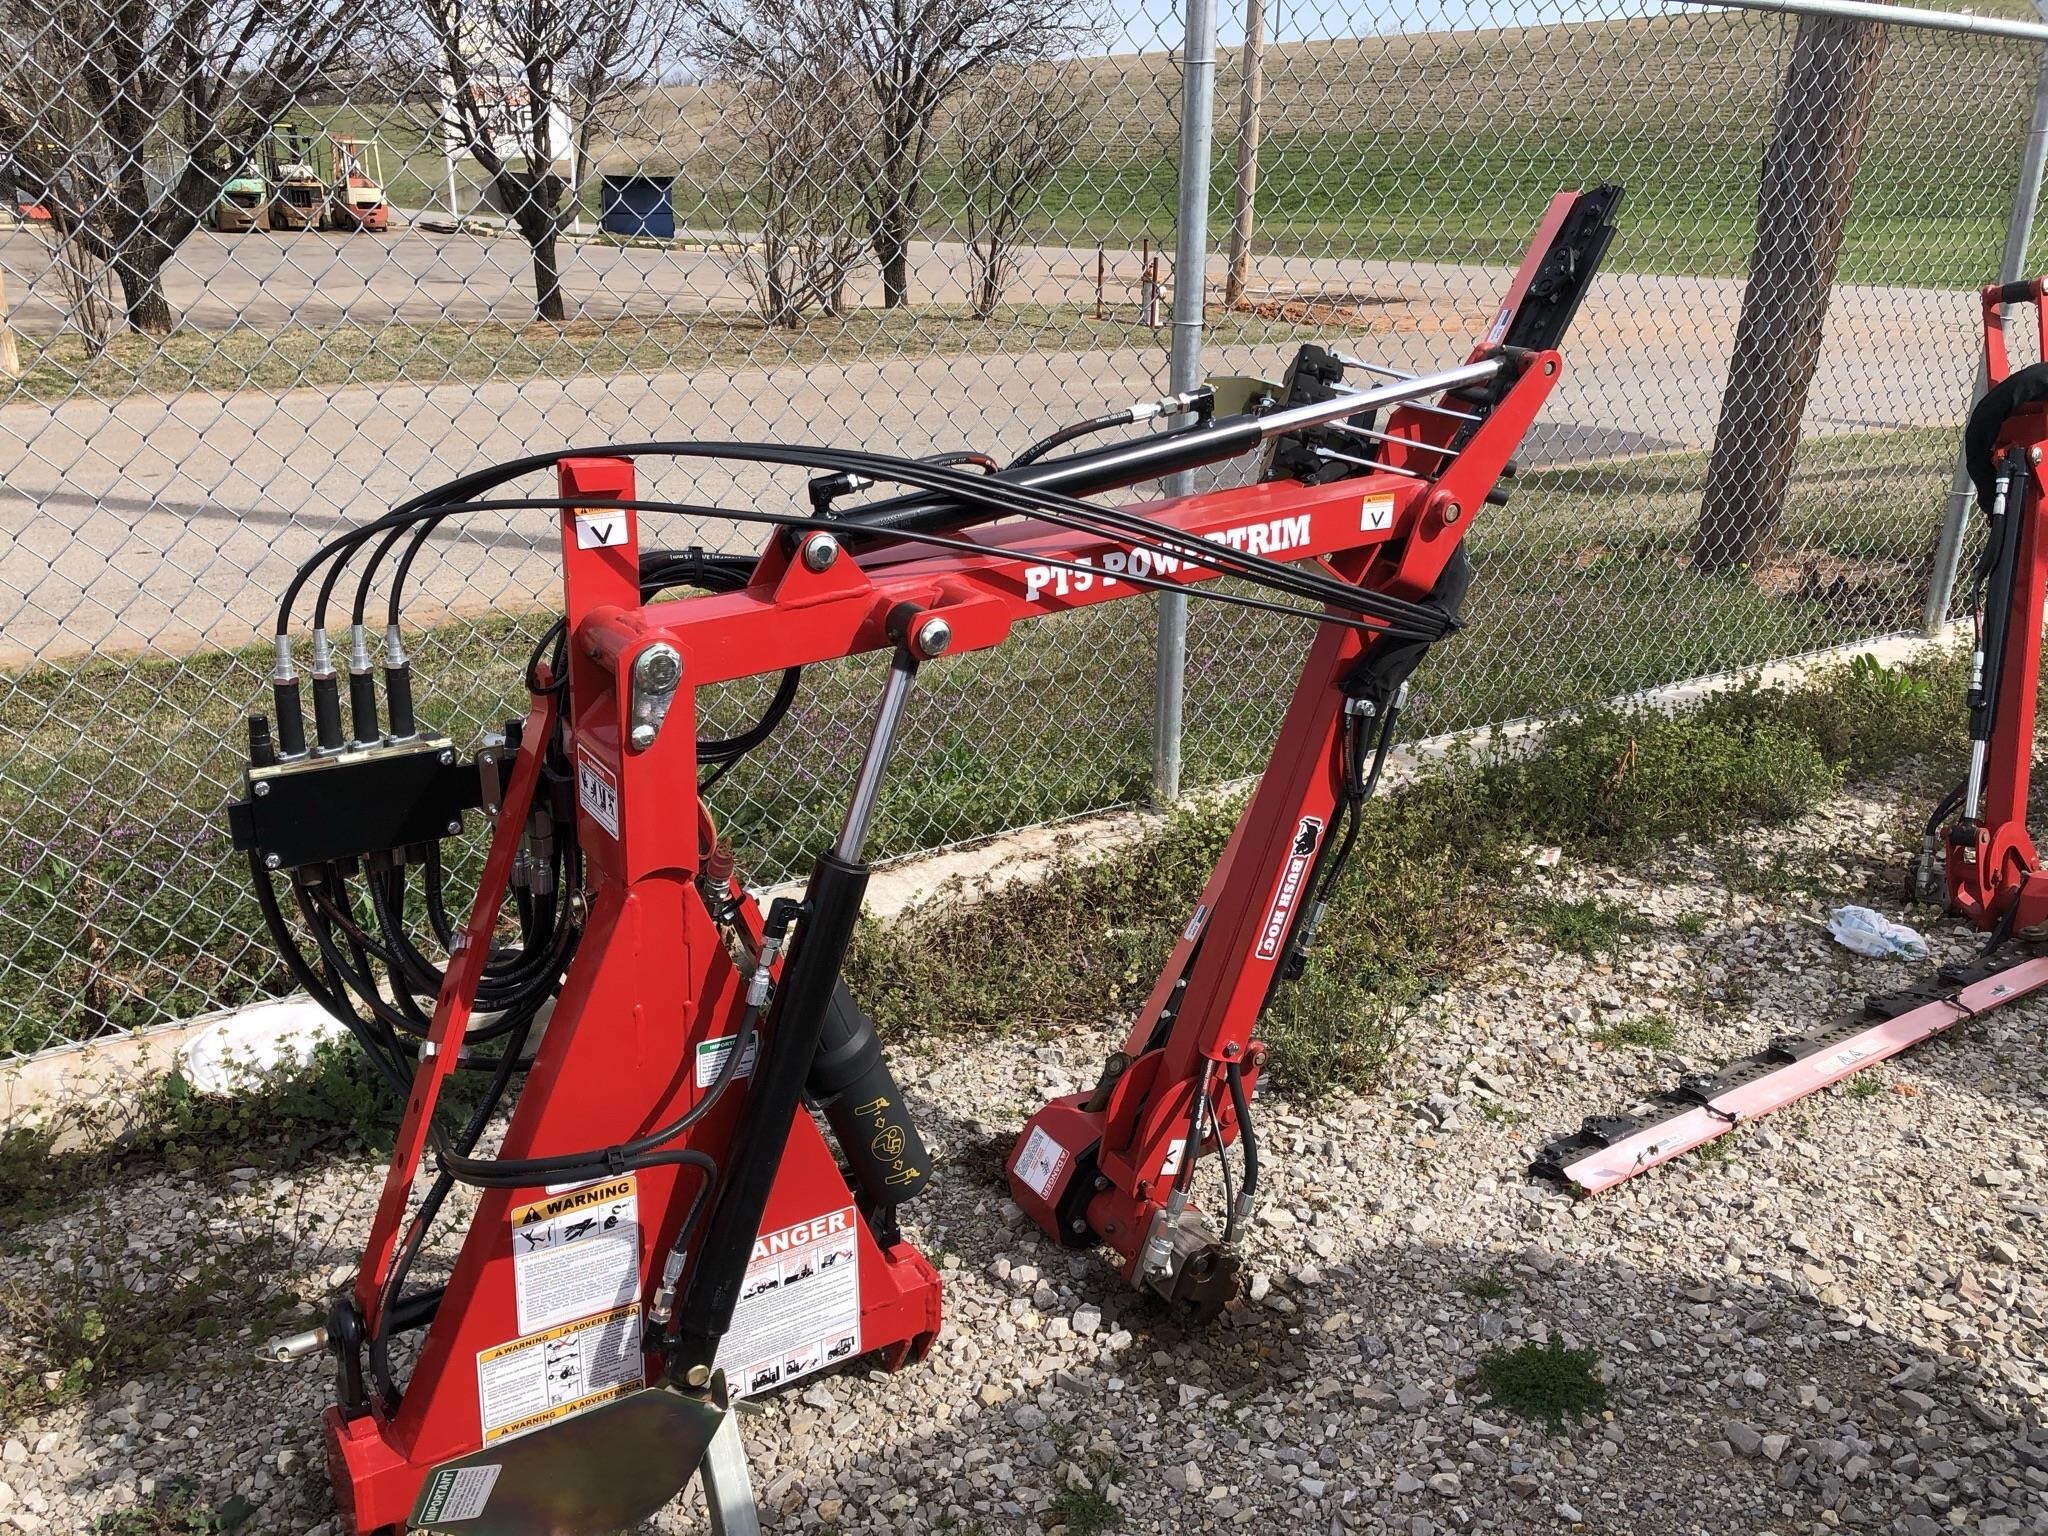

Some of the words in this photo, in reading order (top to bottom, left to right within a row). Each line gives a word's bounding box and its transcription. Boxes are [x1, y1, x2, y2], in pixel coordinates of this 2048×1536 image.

[1025, 557, 1093, 602] PT5
[1277, 858, 1305, 908] BUSH
[1263, 910, 1287, 954] HOG
[1041, 1158, 1065, 1198] DANGER
[546, 1182, 630, 1216] WARNING
[750, 1212, 847, 1261] ANGER
[572, 1308, 638, 1332] ADVERTENCIA
[503, 1334, 550, 1354] WARNING
[578, 1382, 642, 1407] ADVERTENCIA
[510, 1412, 557, 1432] WARNING
[424, 1472, 455, 1522] IMPORTANT
